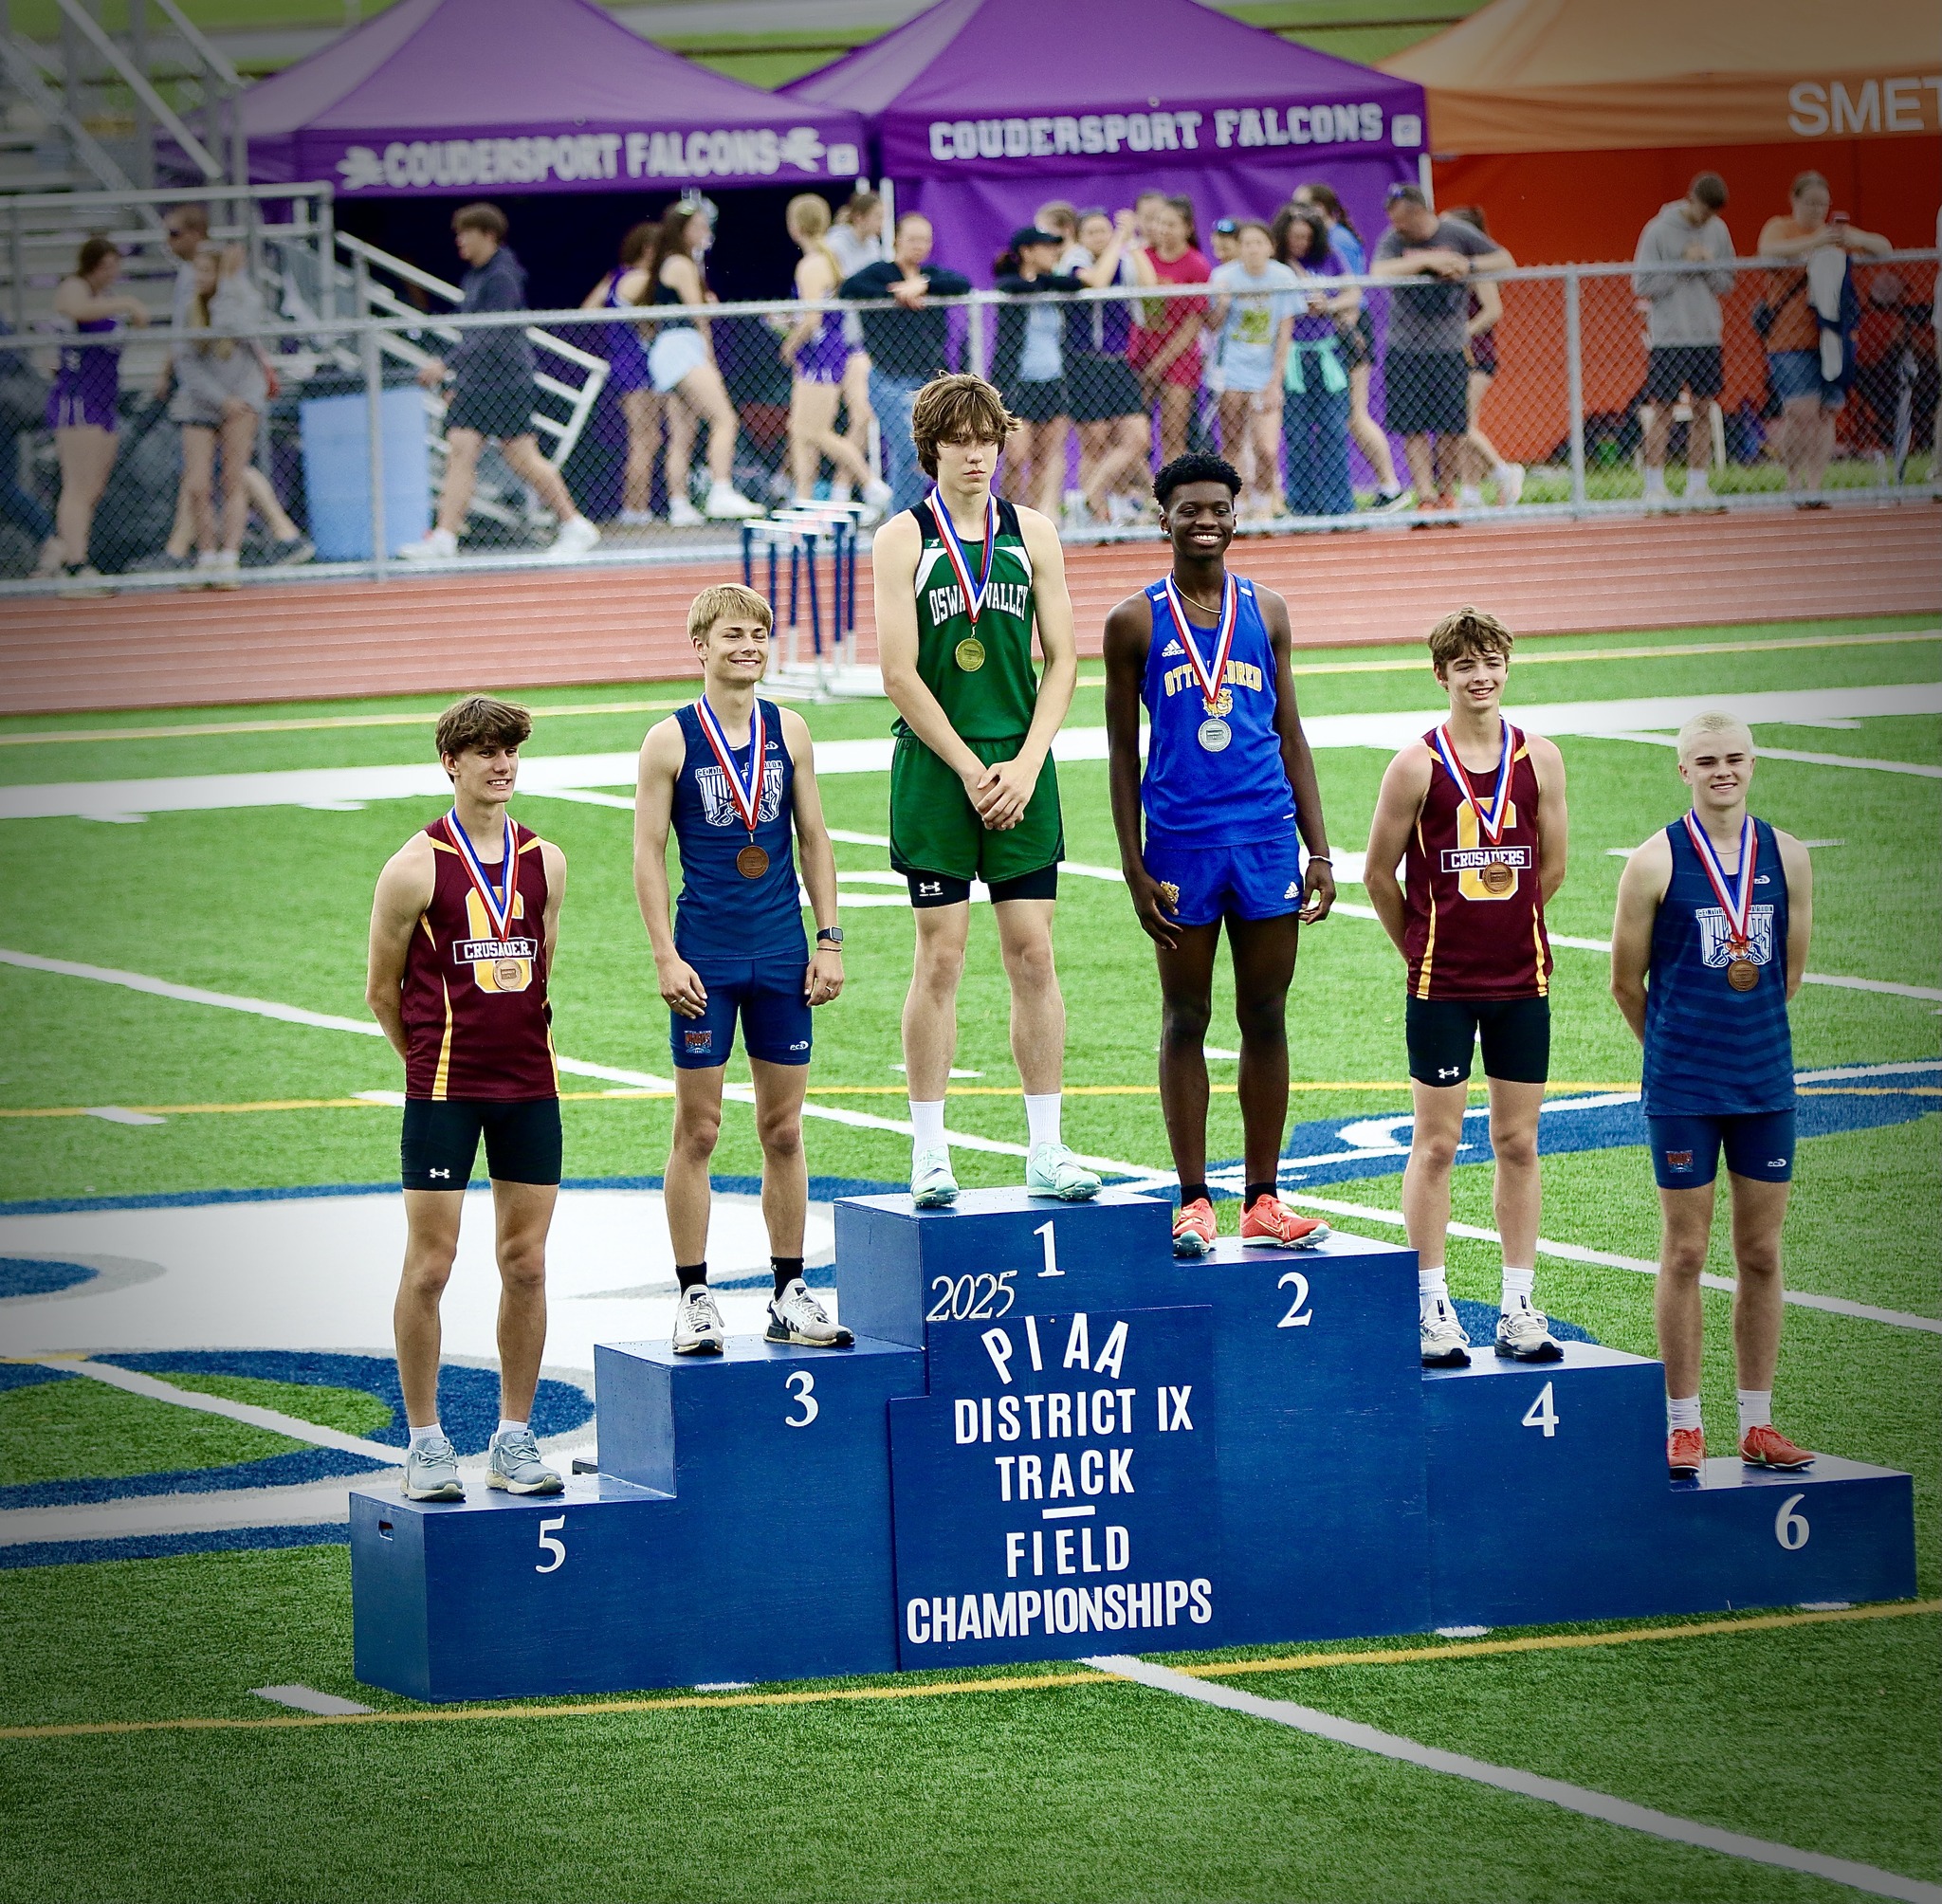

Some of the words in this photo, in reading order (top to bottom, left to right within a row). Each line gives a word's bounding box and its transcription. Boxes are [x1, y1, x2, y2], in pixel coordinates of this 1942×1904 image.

[382, 133, 622, 189] COUDERSPORT
[625, 127, 780, 177] FALCONS
[929, 111, 1202, 160] COUDERSPORT
[1214, 102, 1383, 148] FALCONS
[929, 584, 966, 626] OSWA
[1451, 850, 1525, 868] CRUSADERS
[1033, 1219, 1066, 1277] 1
[926, 1270, 1017, 1322] 2025
[1277, 1272, 1313, 1328] 2
[980, 1312, 1129, 1384] PIAA
[784, 1370, 819, 1427] 3
[954, 1387, 1137, 1444] DISTRICT
[1157, 1385, 1194, 1432] IX
[1521, 1381, 1560, 1437] 4
[995, 1448, 1135, 1502] TRACK
[536, 1513, 566, 1573] 5
[1775, 1492, 1810, 1550] 6
[1006, 1525, 1130, 1578] FIELD
[907, 1578, 1213, 1644] CHAMPIONSHIPS
